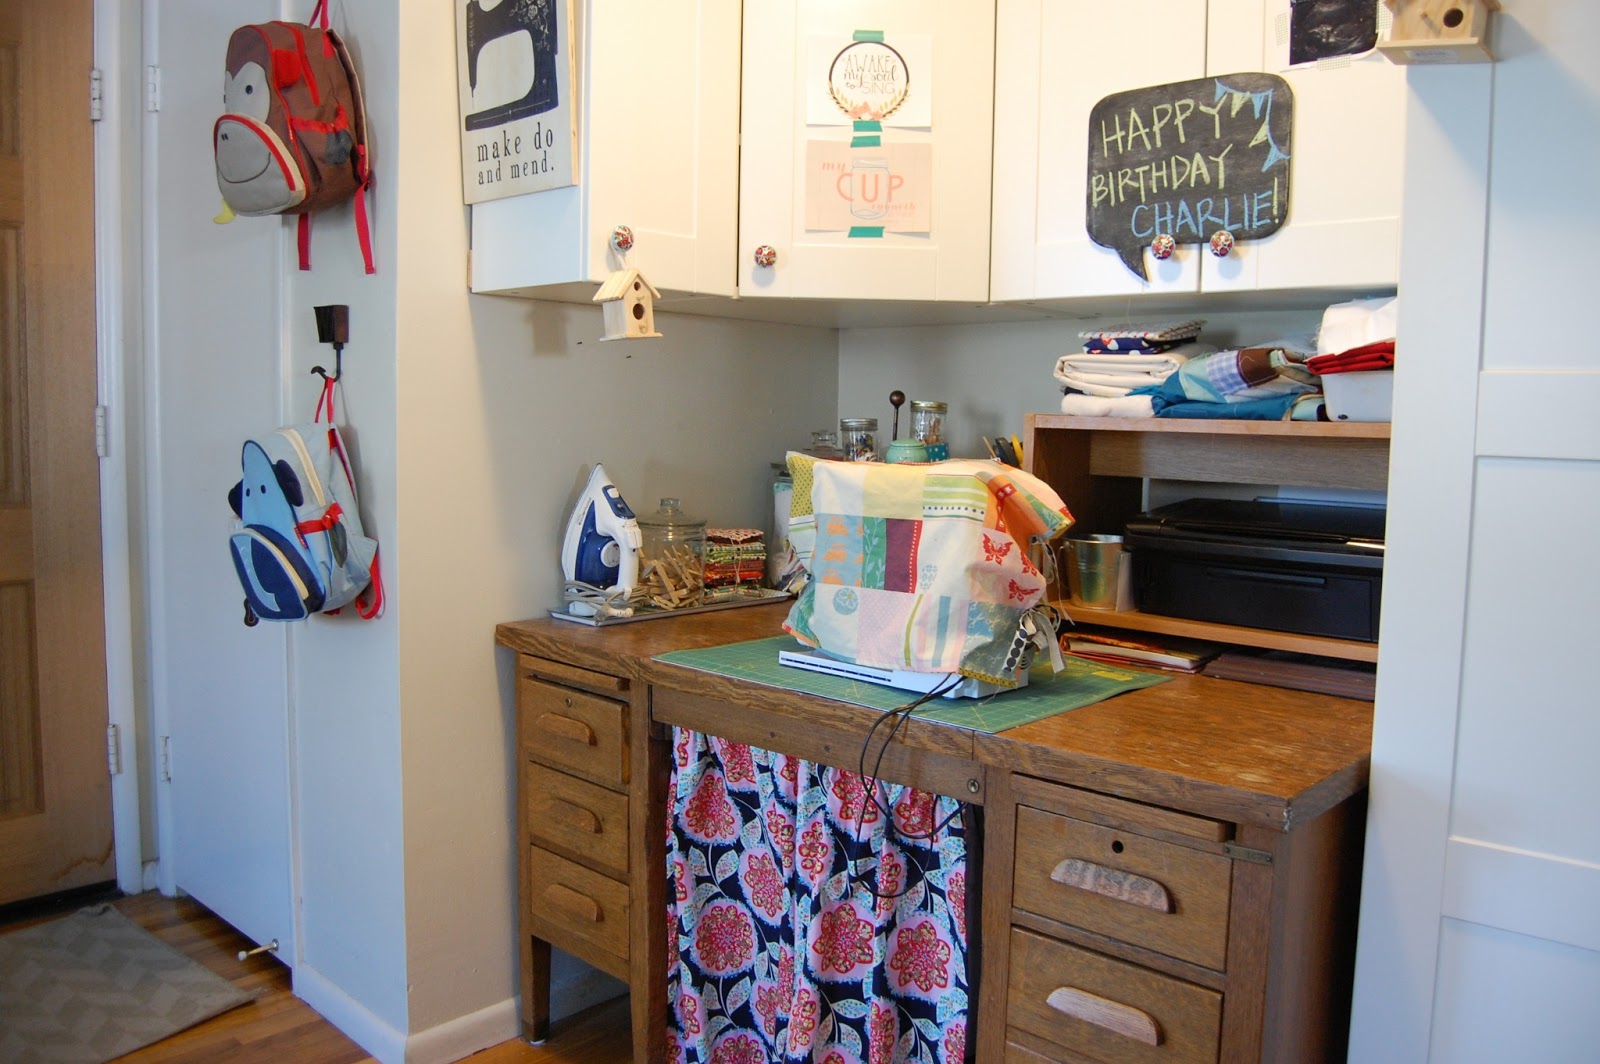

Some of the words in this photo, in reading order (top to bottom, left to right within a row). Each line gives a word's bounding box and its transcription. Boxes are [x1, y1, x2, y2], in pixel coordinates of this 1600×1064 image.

[844, 71, 864, 88] my
[871, 64, 897, 82] soul
[845, 54, 891, 73] AWAKE
[861, 81, 896, 94] SING
[1102, 93, 1228, 157] HAPPY
[477, 130, 521, 162] make
[534, 121, 554, 150] do
[478, 161, 502, 185] and
[511, 151, 555, 179] mend.
[822, 162, 846, 172] my
[1091, 143, 1233, 208] BIRTHDAY
[836, 172, 905, 203] CUP
[1131, 177, 1281, 238] CHARLIE!
